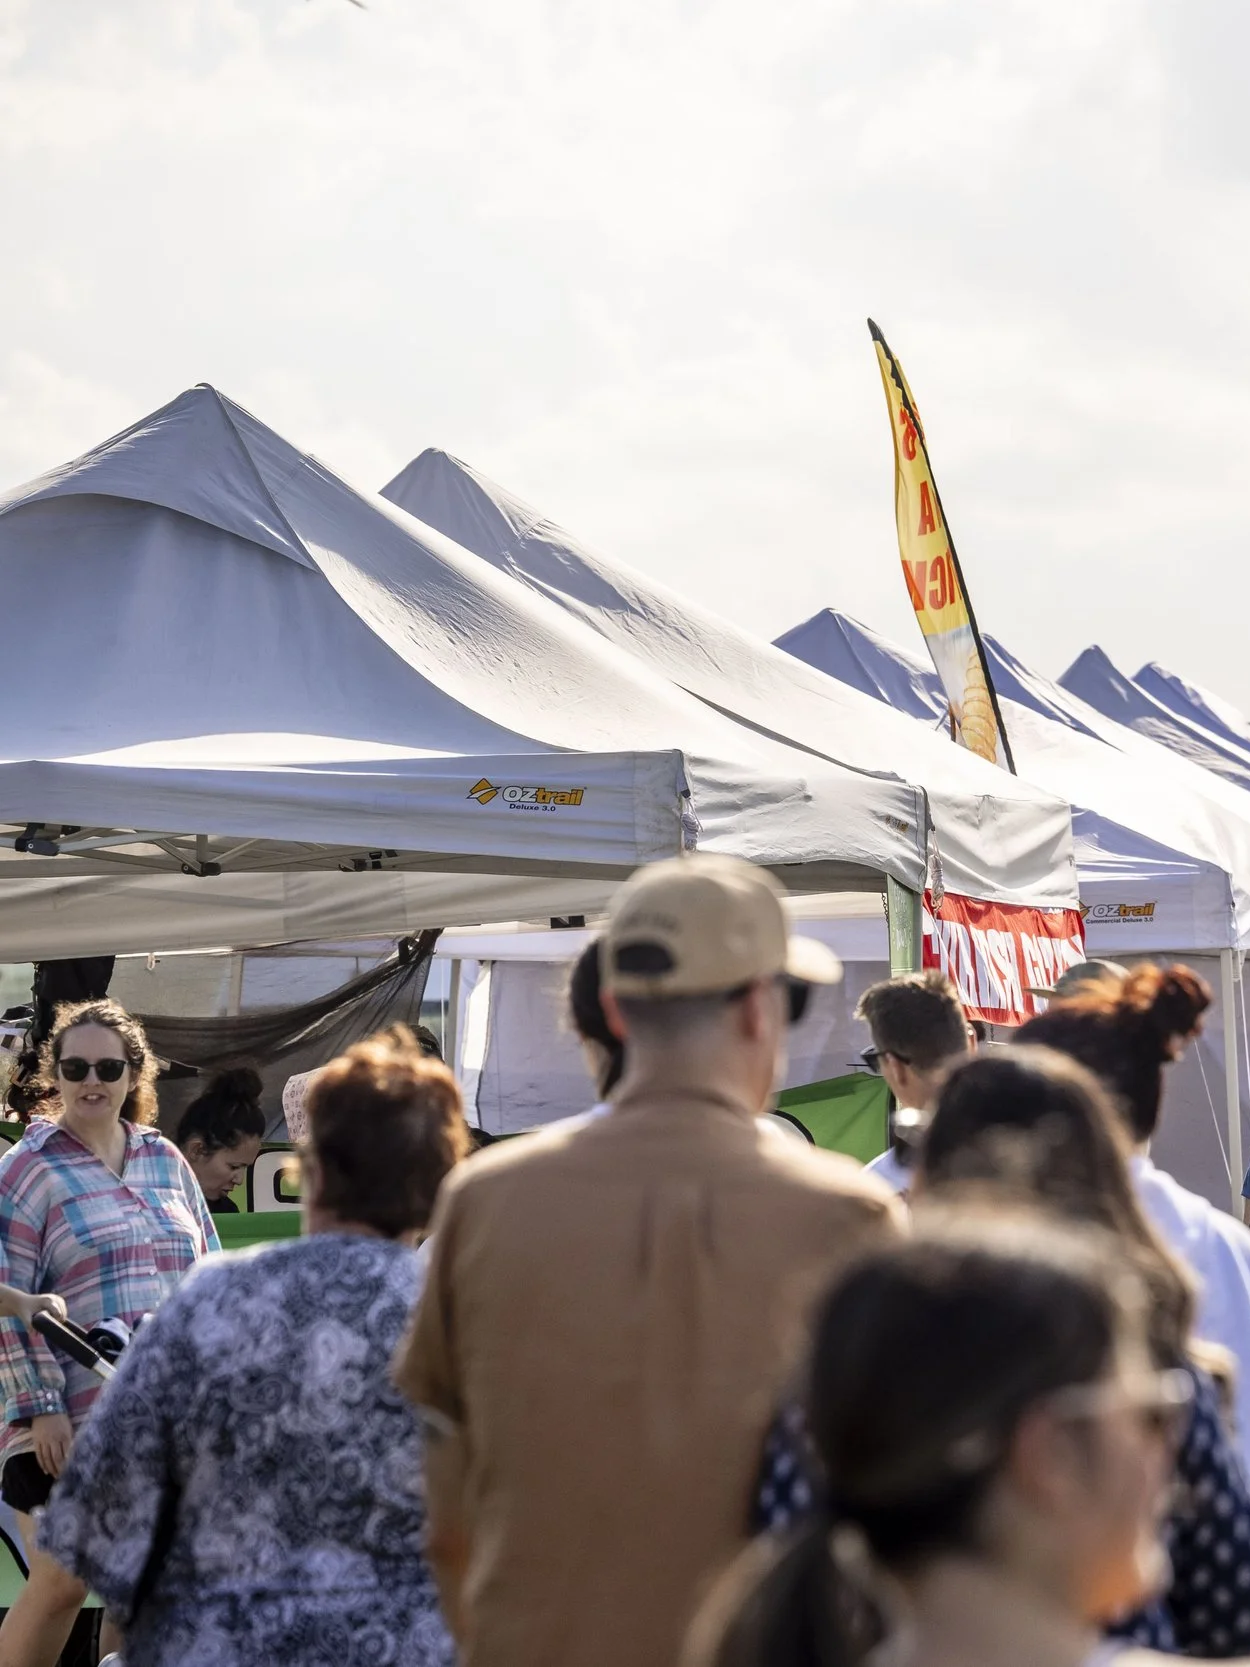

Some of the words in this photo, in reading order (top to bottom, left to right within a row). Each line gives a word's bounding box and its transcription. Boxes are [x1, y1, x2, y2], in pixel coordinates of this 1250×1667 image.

[502, 785, 585, 806] OZtrail
[509, 803, 540, 811] Deluxe
[541, 804, 556, 812] 3.0
[1092, 903, 1156, 918] OZtrail
